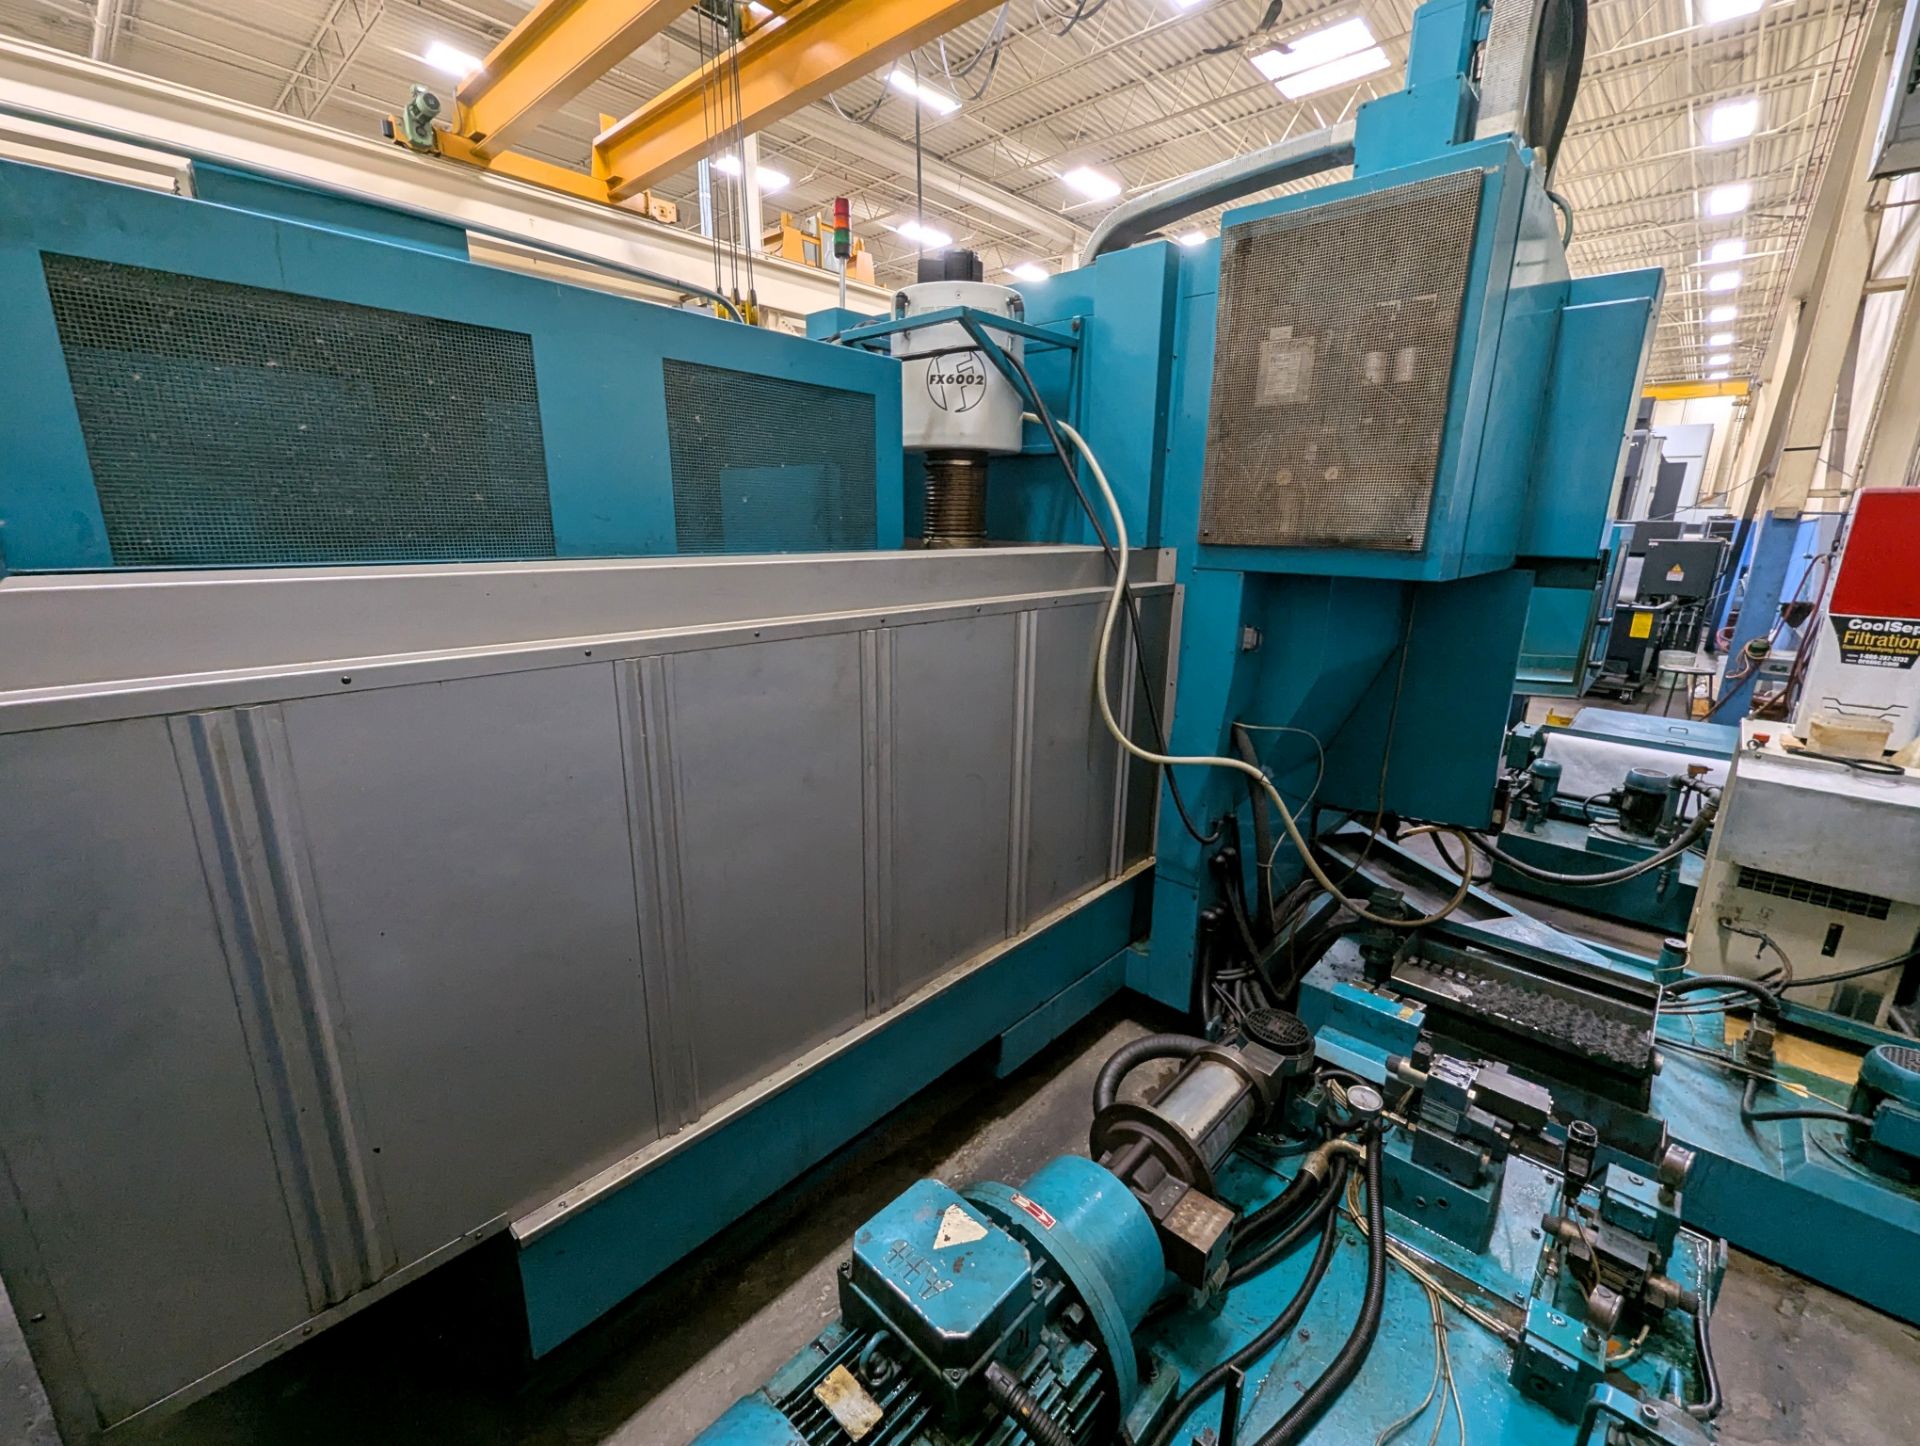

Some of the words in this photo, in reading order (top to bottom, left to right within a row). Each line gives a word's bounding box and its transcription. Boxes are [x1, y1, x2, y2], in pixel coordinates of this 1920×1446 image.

[929, 374, 984, 385] FX6002
[1848, 618, 1920, 636] CoolSep
[1843, 630, 1920, 648] Filtration
